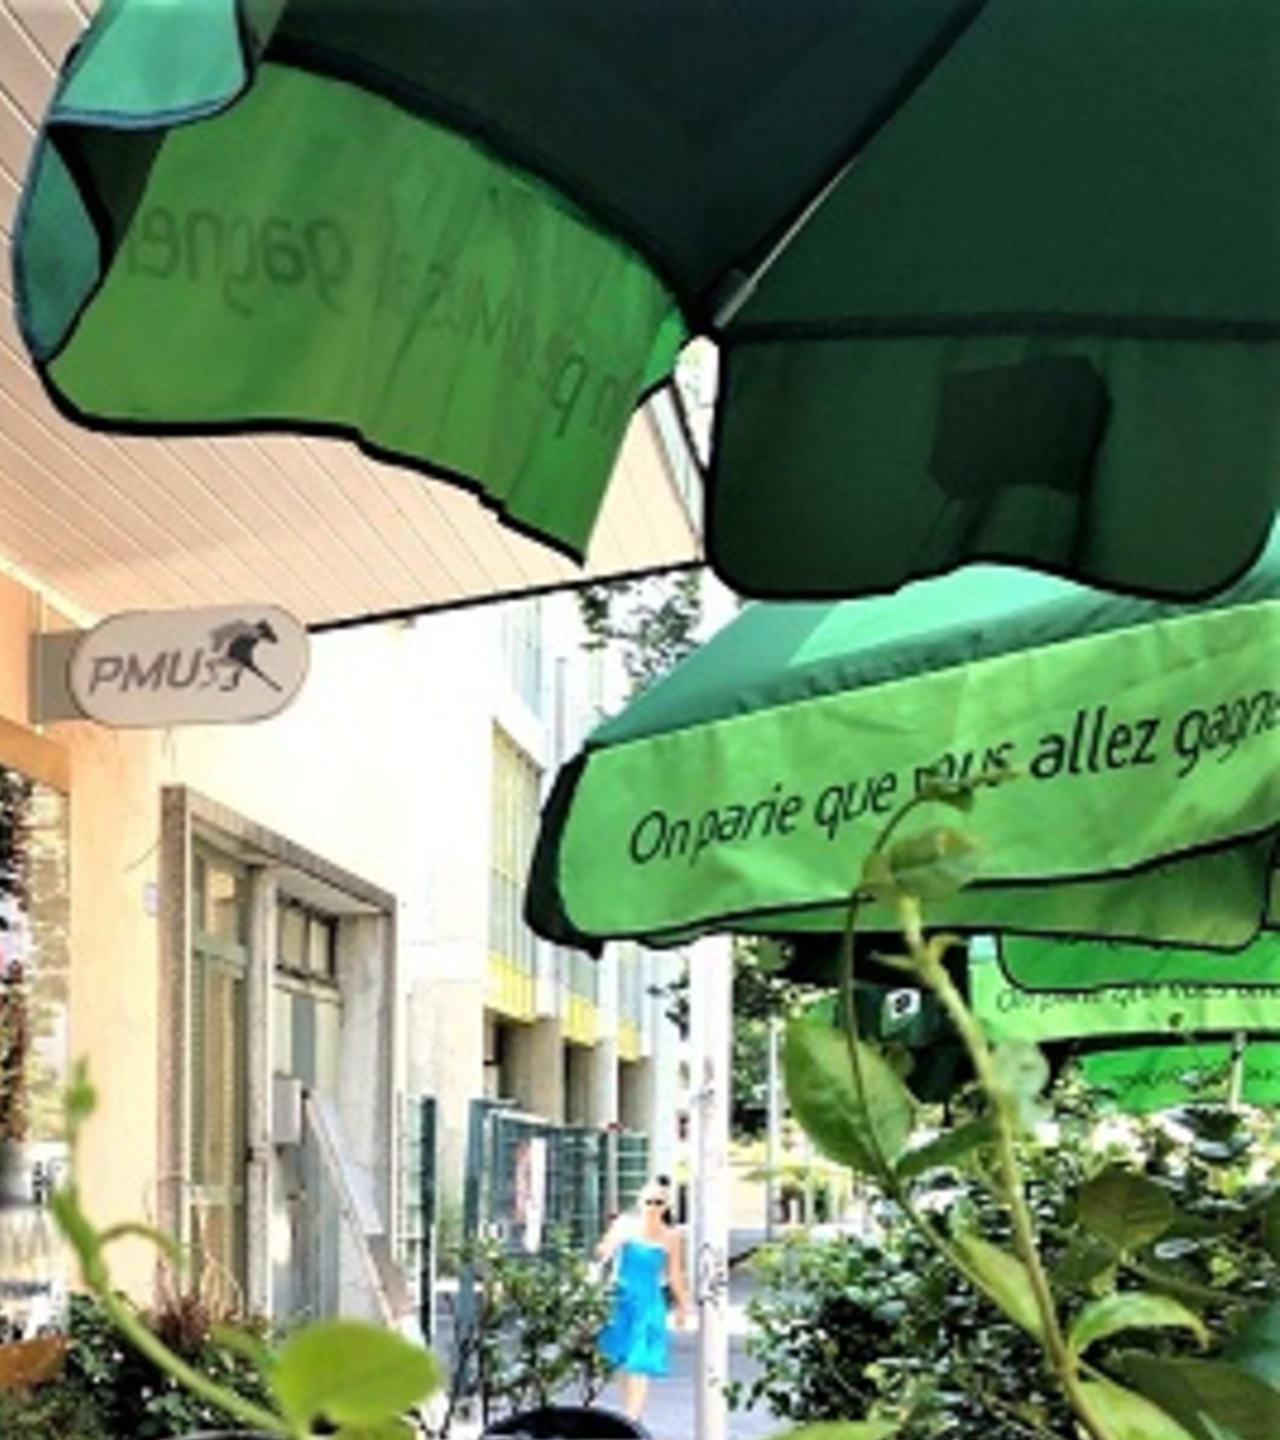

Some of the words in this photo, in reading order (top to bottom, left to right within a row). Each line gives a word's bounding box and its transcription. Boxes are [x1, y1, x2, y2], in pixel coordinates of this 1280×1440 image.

[88, 647, 204, 695] PMU
[629, 809, 690, 866] On
[690, 782, 805, 868] parie
[814, 771, 898, 841] que
[1029, 704, 1161, 781] allez
